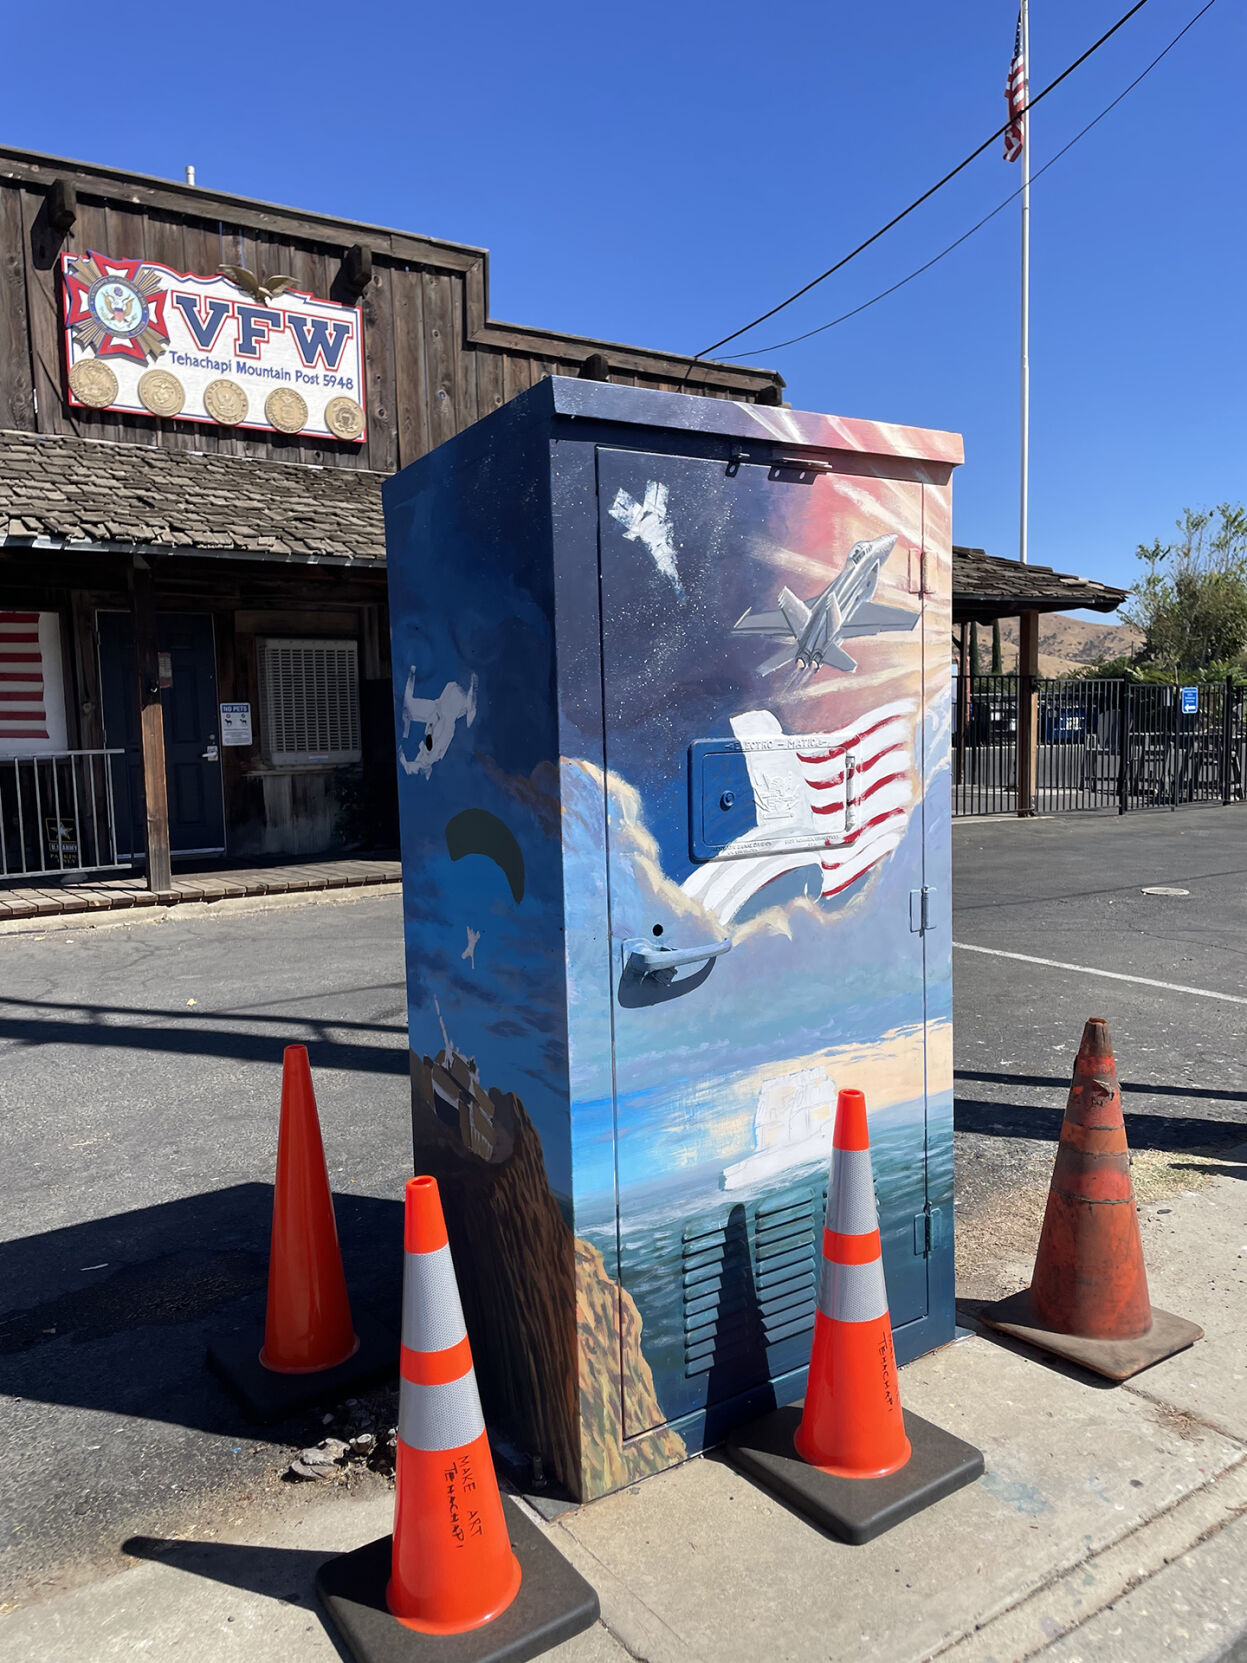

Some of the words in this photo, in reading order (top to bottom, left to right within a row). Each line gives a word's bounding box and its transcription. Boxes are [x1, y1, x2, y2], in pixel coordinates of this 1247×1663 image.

[169, 350, 232, 374] Tehachapi
[236, 361, 291, 381] Mountain
[295, 370, 320, 386] Post
[323, 374, 354, 390] 5948
[171, 290, 353, 371] VFW
[458, 1455, 476, 1493] MAKE
[467, 1510, 482, 1537] ART
